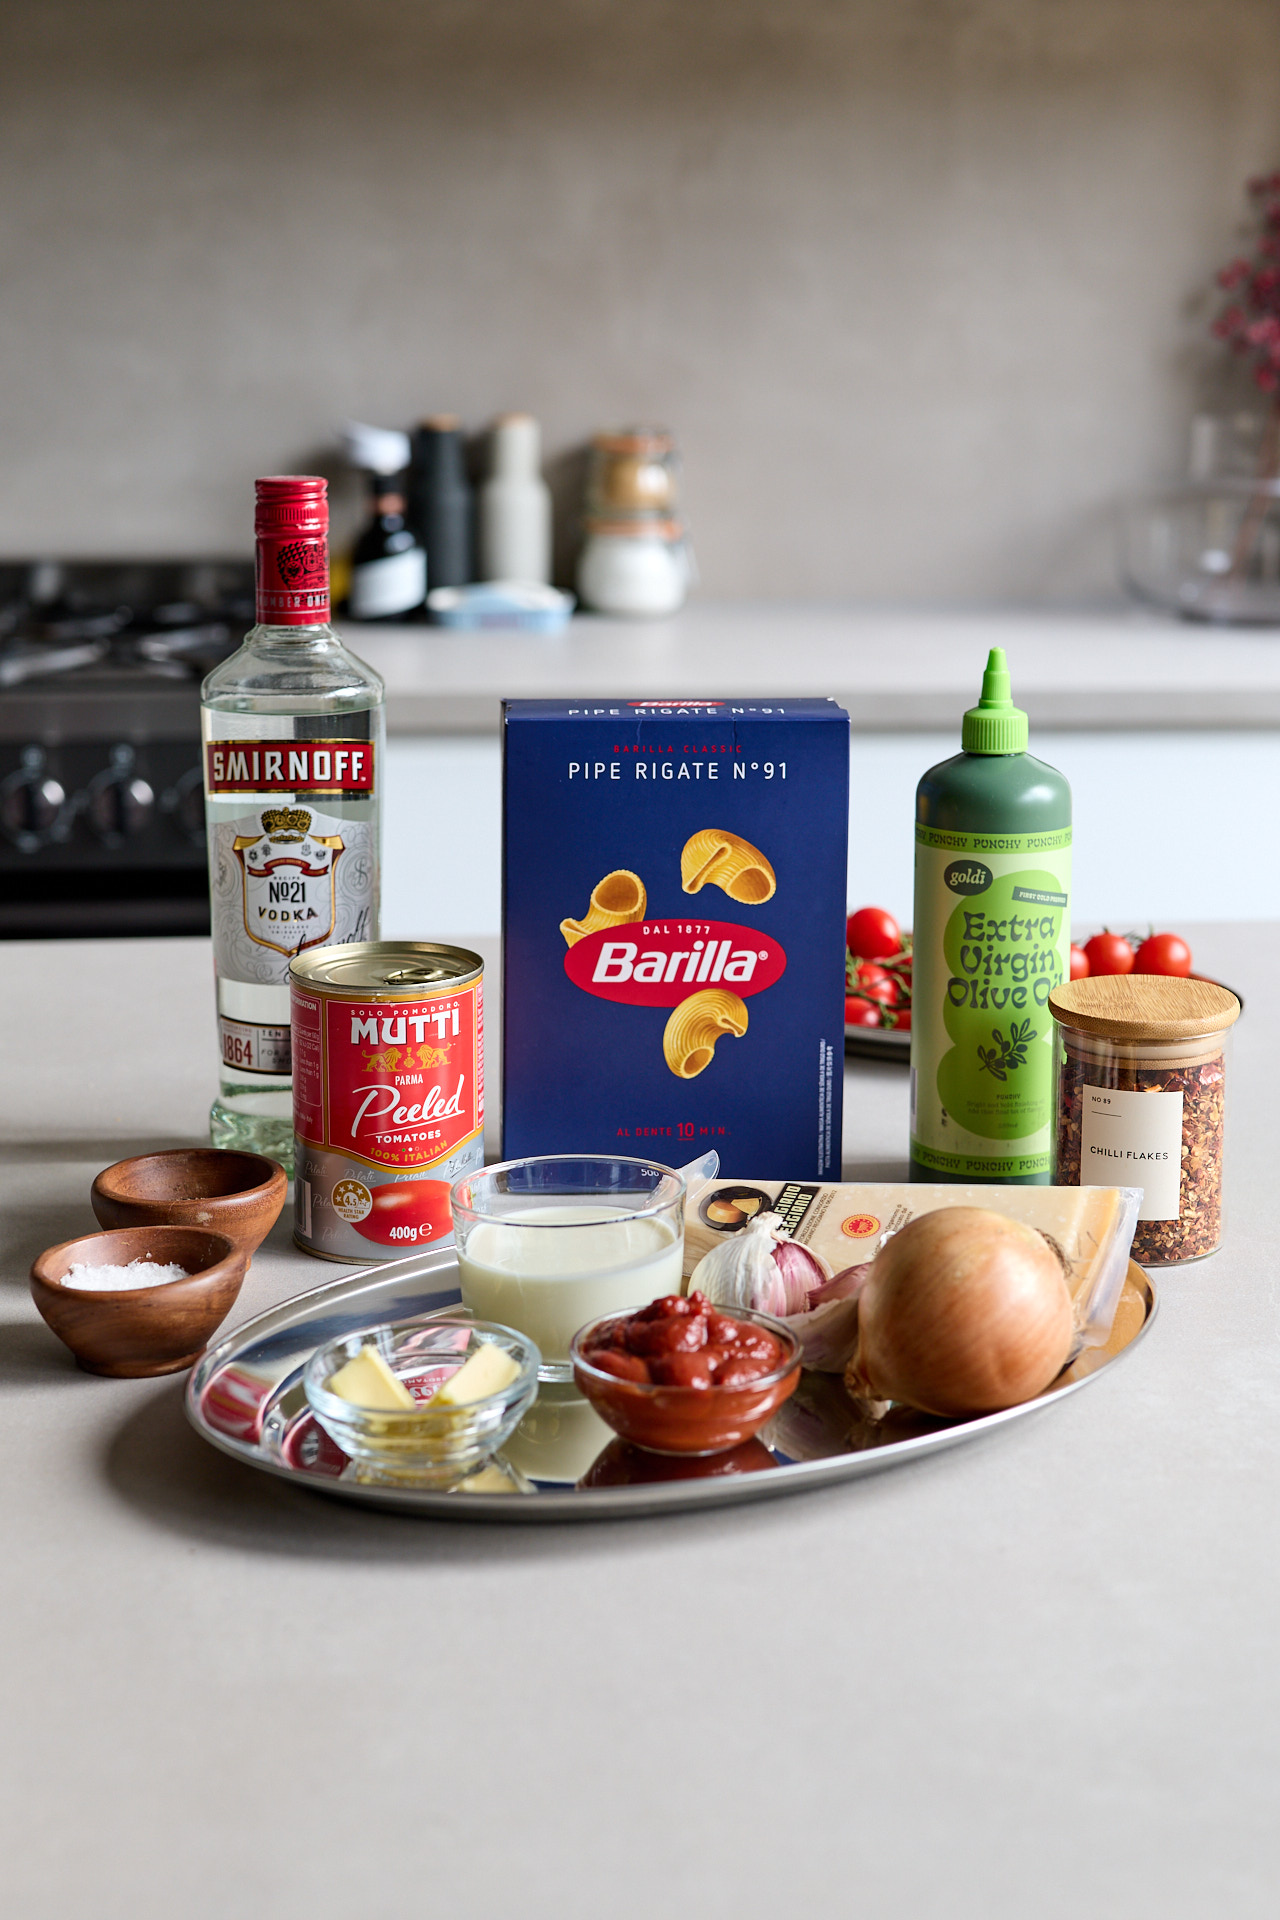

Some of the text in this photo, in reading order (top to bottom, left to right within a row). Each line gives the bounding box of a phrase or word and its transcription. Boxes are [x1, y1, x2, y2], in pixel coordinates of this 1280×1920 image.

[569, 708, 620, 716] PIPE
[613, 745, 743, 753] BARILLA CLASSIC
[213, 751, 366, 782] SMIRNOFF
[568, 762, 621, 780] PIPE
[635, 762, 719, 780] RIGATE
[929, 832, 968, 848] PUNCHY
[973, 838, 1021, 849] PUNCHY
[1027, 835, 1063, 848] PUNCHY
[949, 868, 986, 886] goldi
[258, 906, 319, 921] VODKA
[643, 925, 711, 935] DAL 1877
[963, 911, 1055, 942] Extra
[960, 943, 1055, 982] Virgin
[947, 977, 1028, 1010] Olive
[262, 1029, 281, 1037] TEN
[351, 1008, 459, 1045] MUTTI
[223, 1033, 253, 1065] 1864
[395, 1073, 424, 1086] PARMA
[351, 1074, 465, 1138] Peeled
[375, 1129, 441, 1144] TOMATOES
[617, 1122, 731, 1137] AL DENTE 10 MIN.
[370, 1140, 448, 1162] 100% ITALIAN
[1090, 1146, 1169, 1160] CHILLI FLAKES
[922, 1152, 960, 1168] PUNCHY
[966, 1160, 1013, 1171] PUNCHY
[312, 1193, 332, 1208] Pela
[345, 1195, 357, 1206] 4.5
[780, 1193, 813, 1238] EGGIANO
[389, 1225, 418, 1241] 400g
